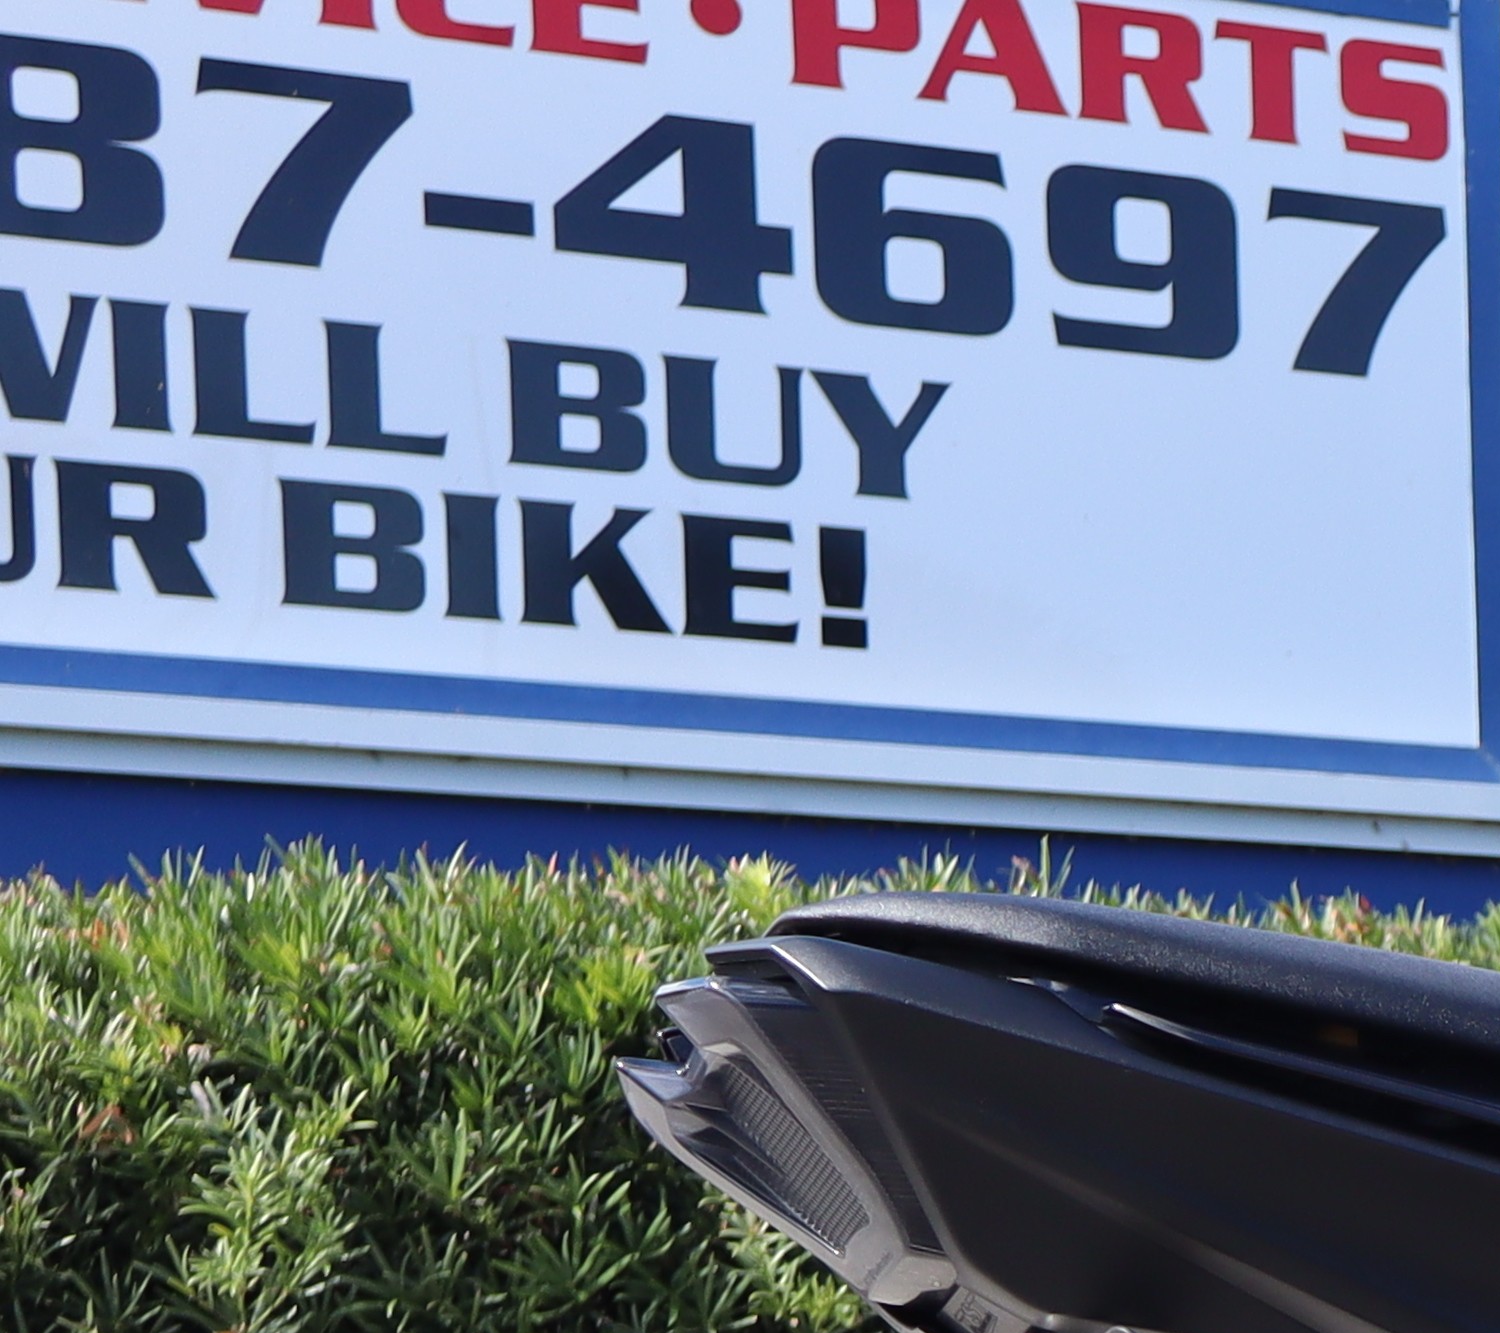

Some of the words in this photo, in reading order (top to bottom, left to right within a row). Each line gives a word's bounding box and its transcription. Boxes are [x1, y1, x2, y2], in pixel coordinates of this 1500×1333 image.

[792, 0, 1449, 162] PARTS
[505, 338, 951, 501] BUY
[279, 477, 868, 650] BIKE!
